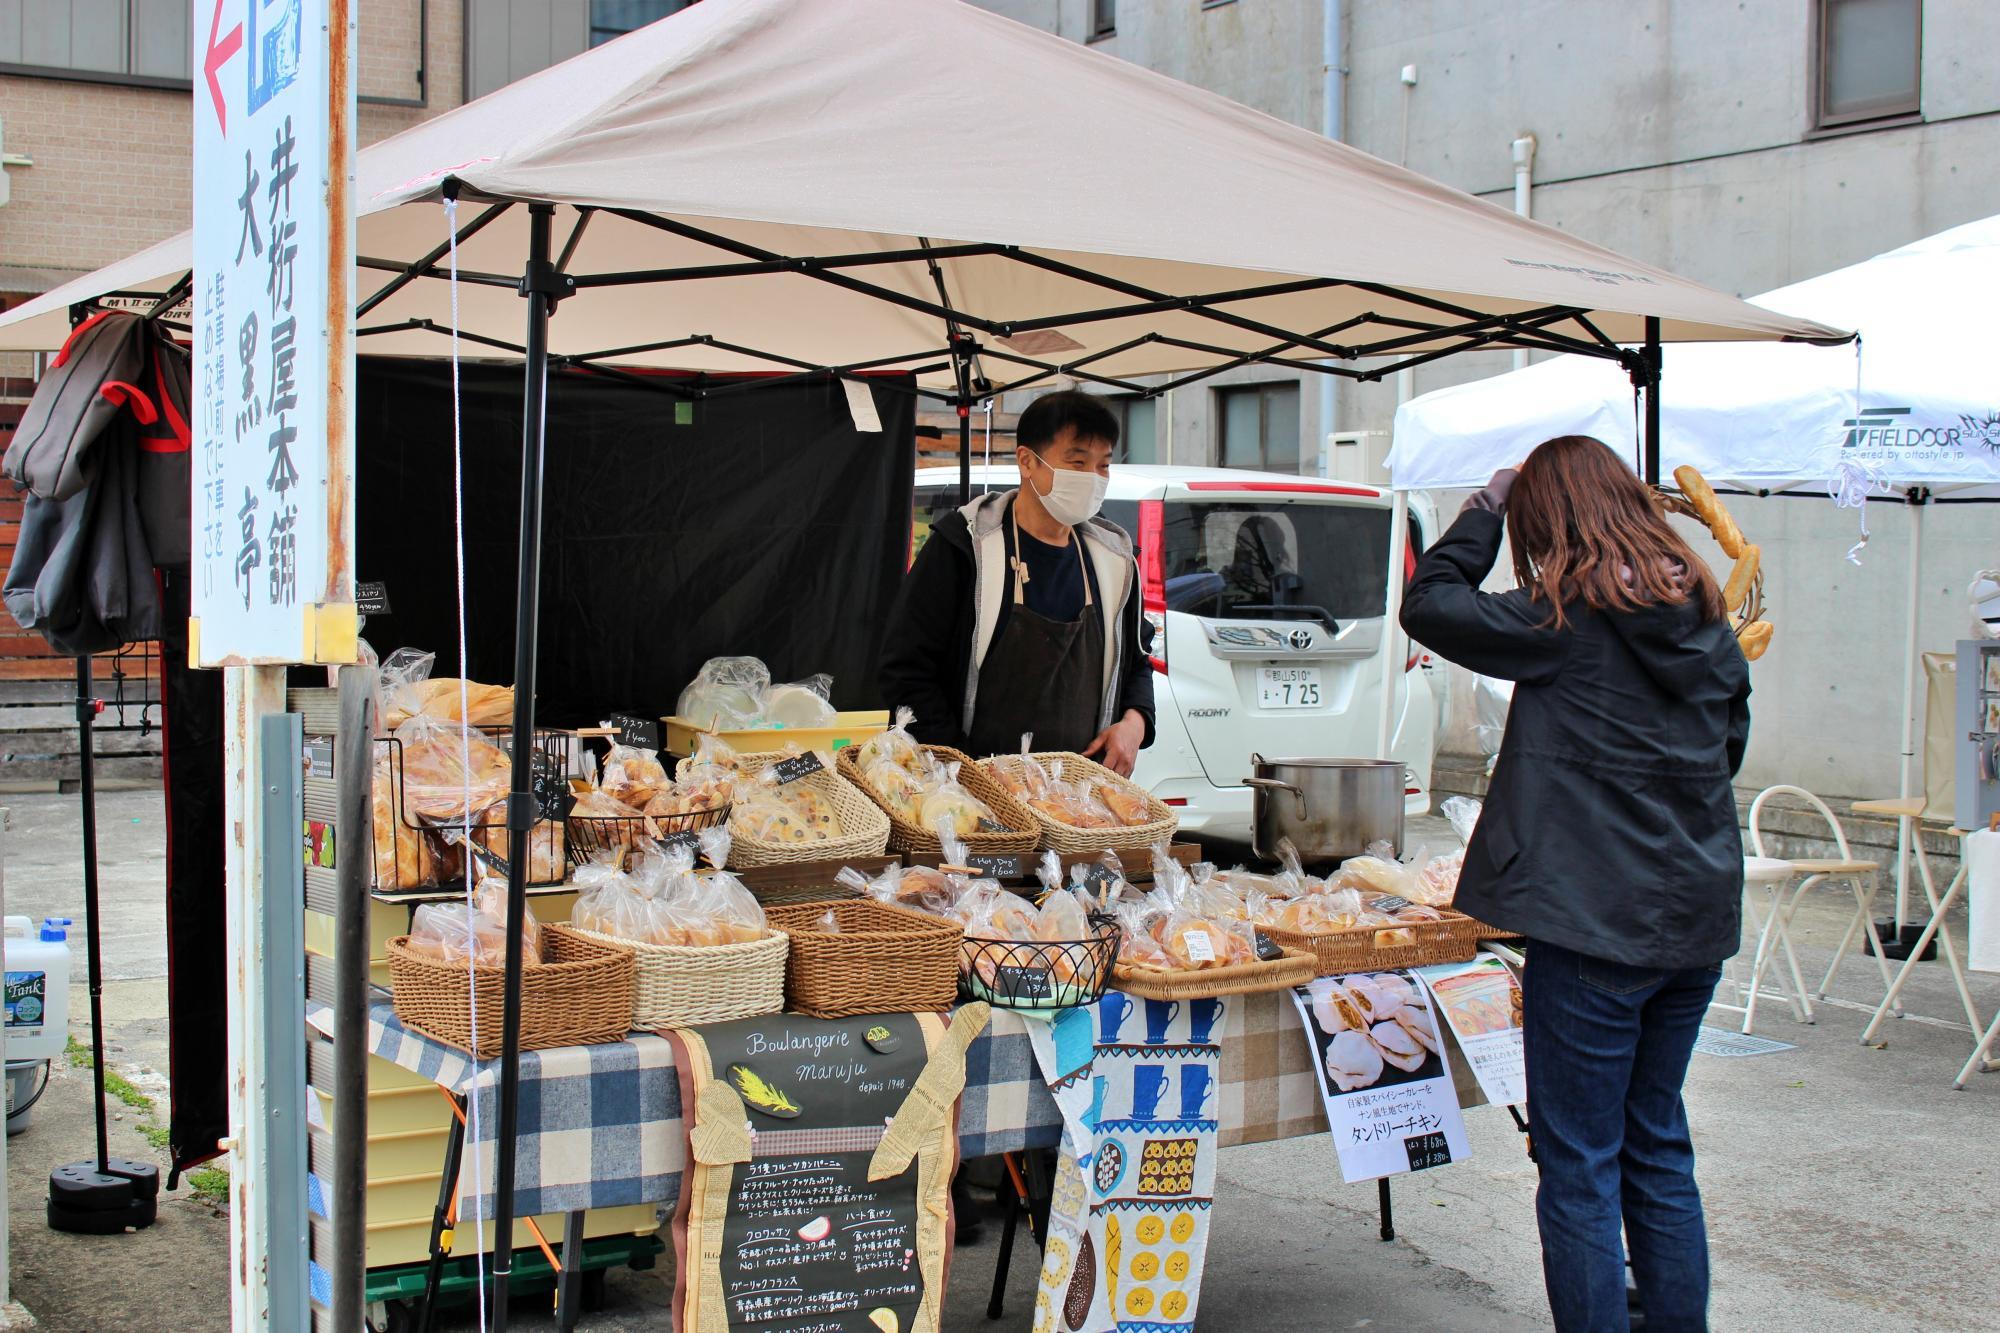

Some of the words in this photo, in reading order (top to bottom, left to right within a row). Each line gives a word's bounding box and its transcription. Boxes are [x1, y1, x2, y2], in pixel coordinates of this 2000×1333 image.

[266, 115, 299, 609] 井桁屋本舗
[235, 148, 263, 612] 大黒亭
[215, 269, 225, 557] 駐車場前に車を
[204, 276, 214, 599] 止めないで下さい
[1868, 428, 1961, 447] FIELDOOR
[1888, 449, 1900, 461] by
[1188, 708, 1231, 718] ROOMY
[746, 1030, 850, 1057] Boulangerie
[858, 1080, 884, 1094] depuis
[1347, 1084, 1433, 1109] 自家製スパイシーカレーを
[1352, 1114, 1443, 1145] タンドリーチキン
[746, 1228, 791, 1242] クロワッサン
[730, 1276, 798, 1291] ガーリックフランス
